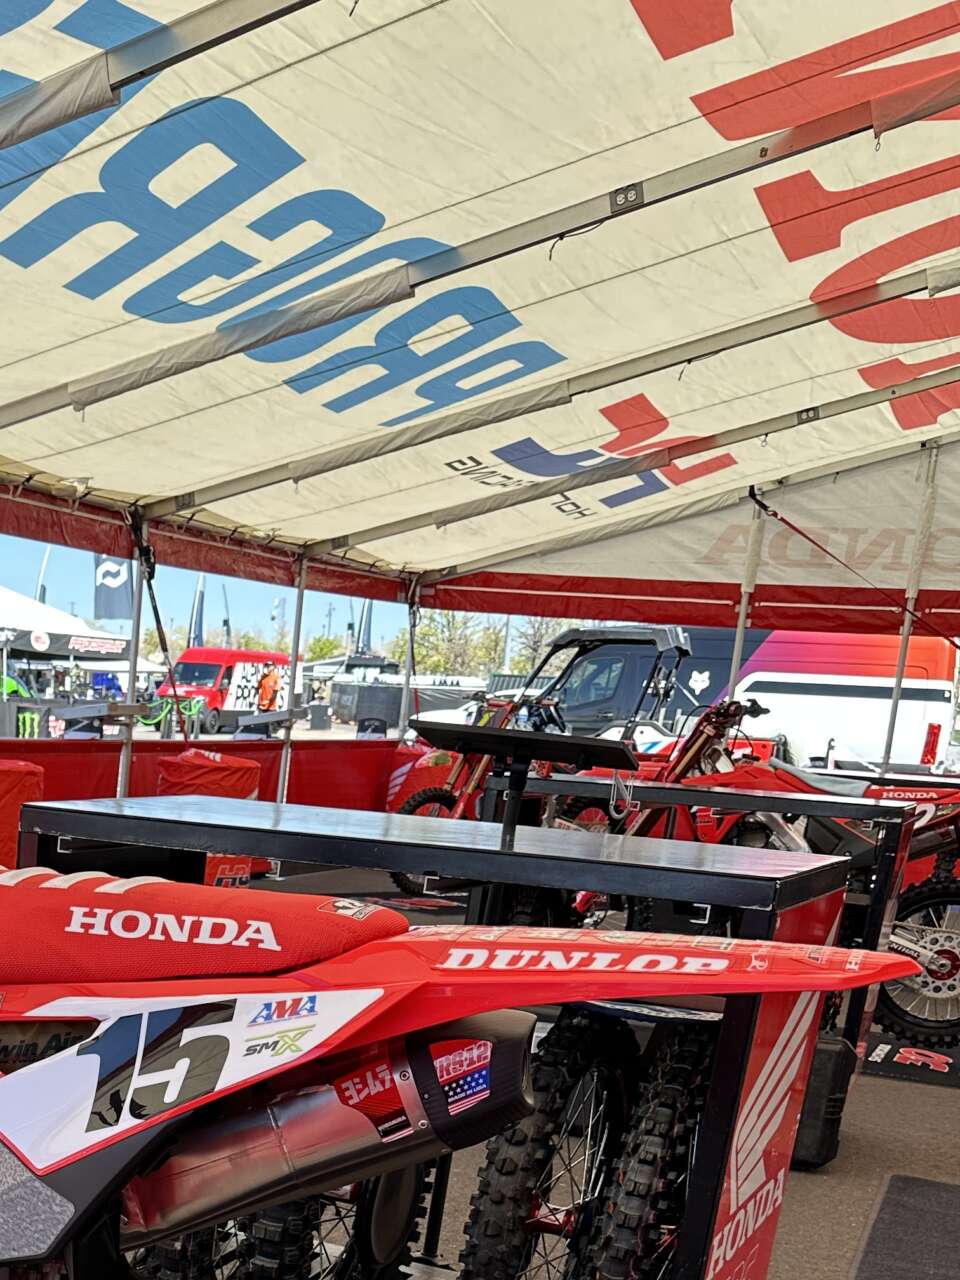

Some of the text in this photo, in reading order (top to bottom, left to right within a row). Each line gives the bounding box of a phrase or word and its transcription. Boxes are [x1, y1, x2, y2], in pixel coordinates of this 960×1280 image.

[882, 791, 939, 799] HONDA
[64, 906, 282, 951] HONDA
[434, 948, 730, 974] DUNLOP
[246, 995, 318, 1027] AMA
[44, 1031, 89, 1056] Air
[242, 1026, 312, 1058] SMX
[76, 998, 238, 1133] 15
[342, 1063, 393, 1106] ヨシムラ
